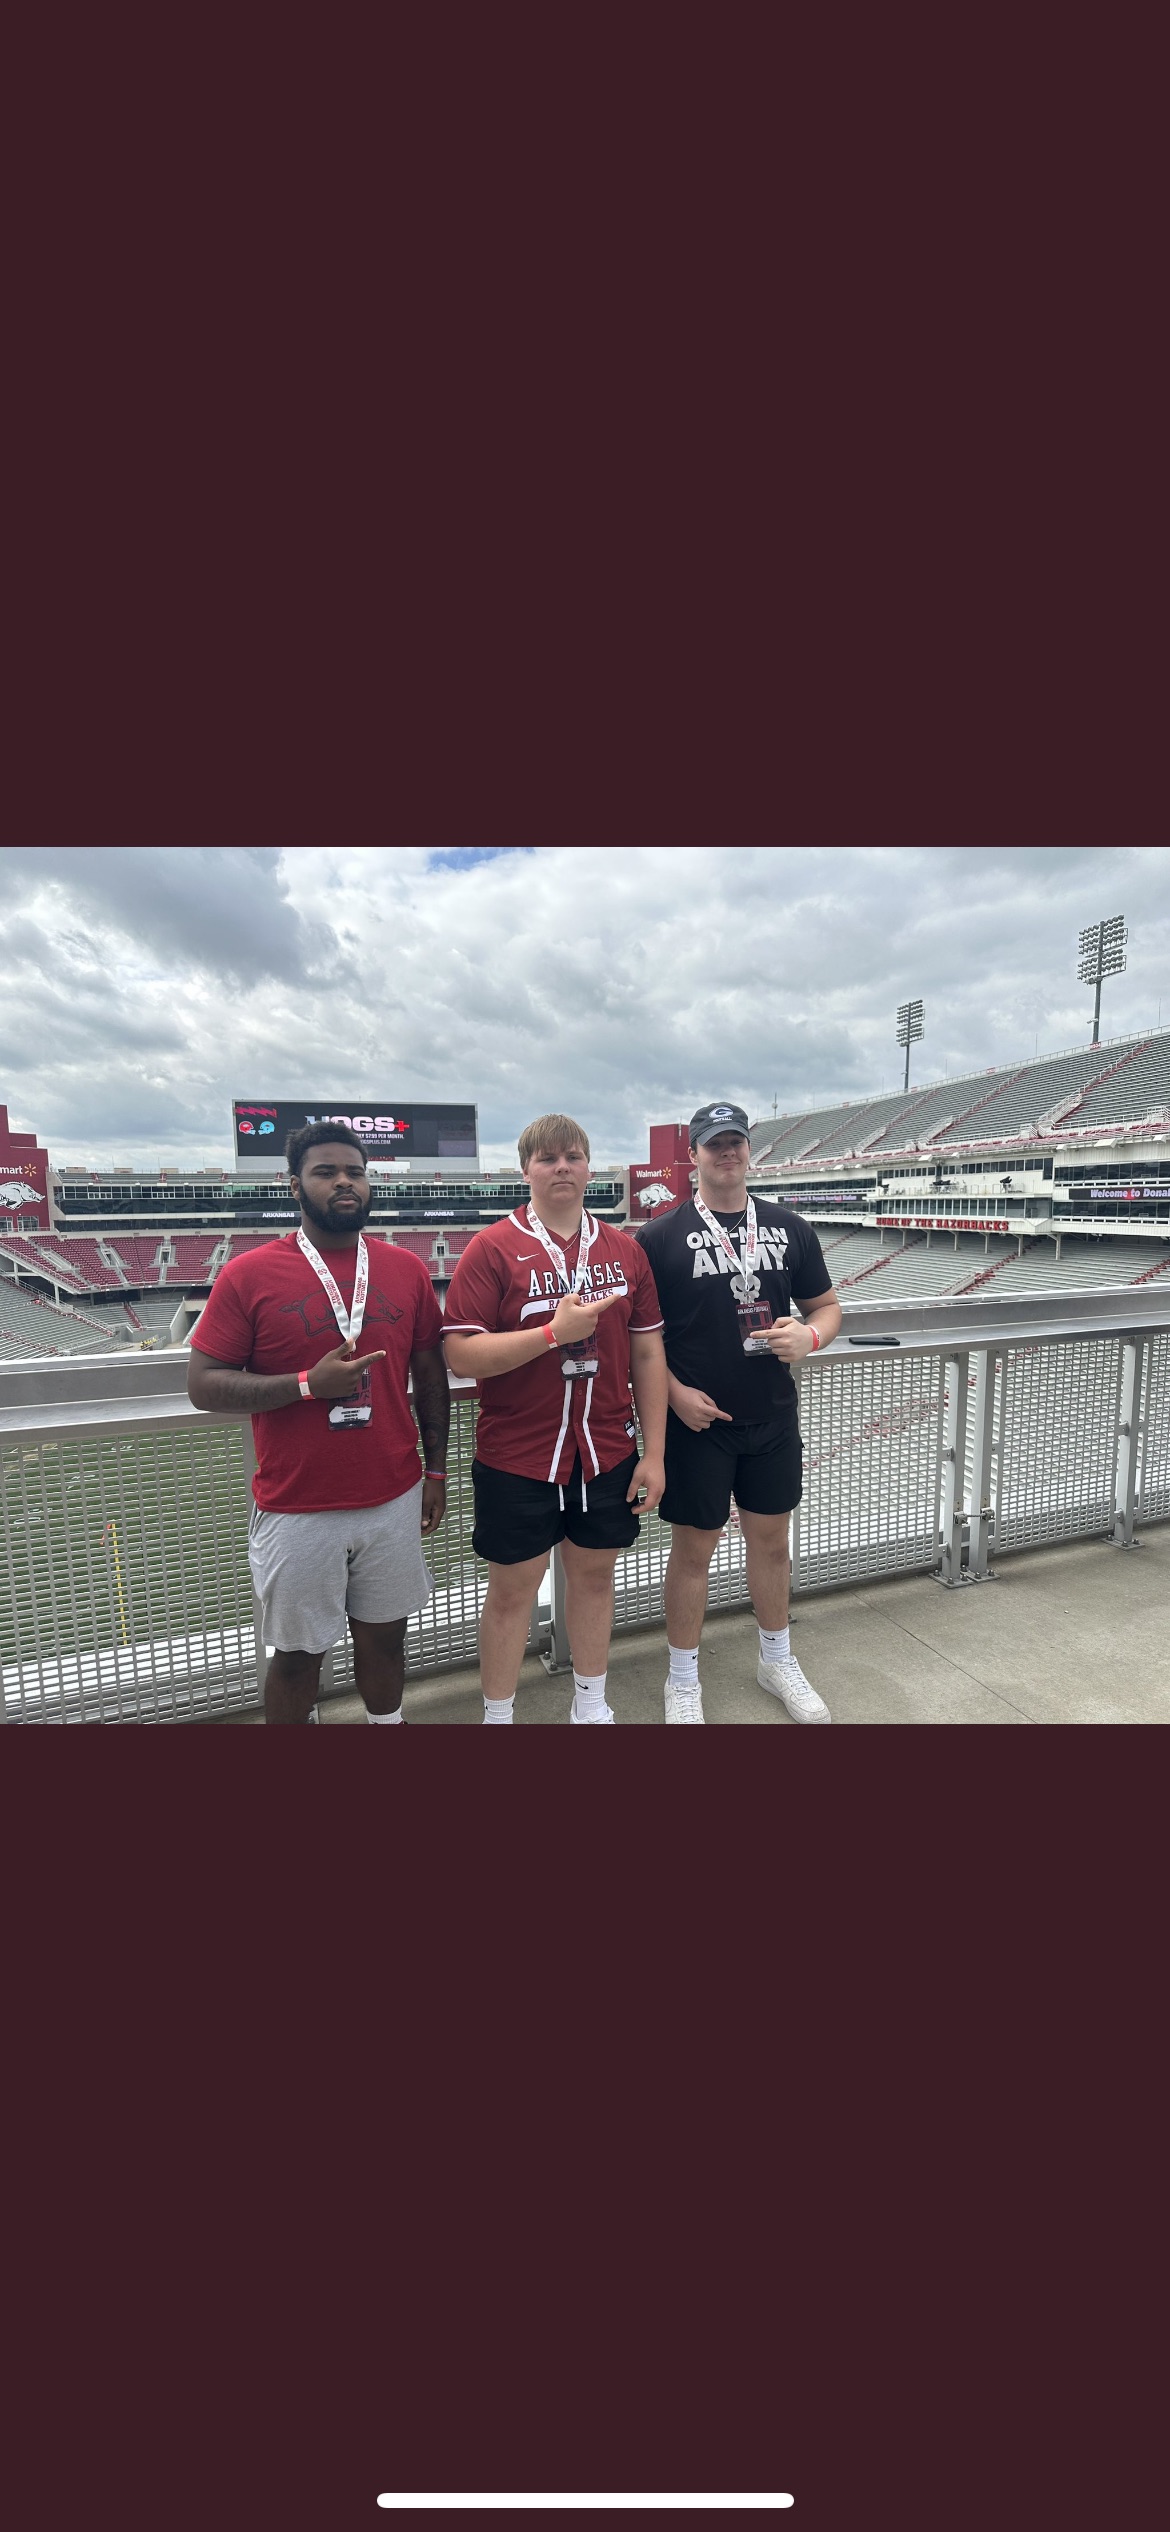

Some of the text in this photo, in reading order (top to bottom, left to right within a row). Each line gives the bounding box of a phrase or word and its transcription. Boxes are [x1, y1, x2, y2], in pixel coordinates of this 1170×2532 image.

[636, 1169, 662, 1178] Walmart
[1090, 1188, 1170, 1198] Welcome to Donal
[876, 1217, 1009, 1231] HOME OF THE RAZORBACKS
